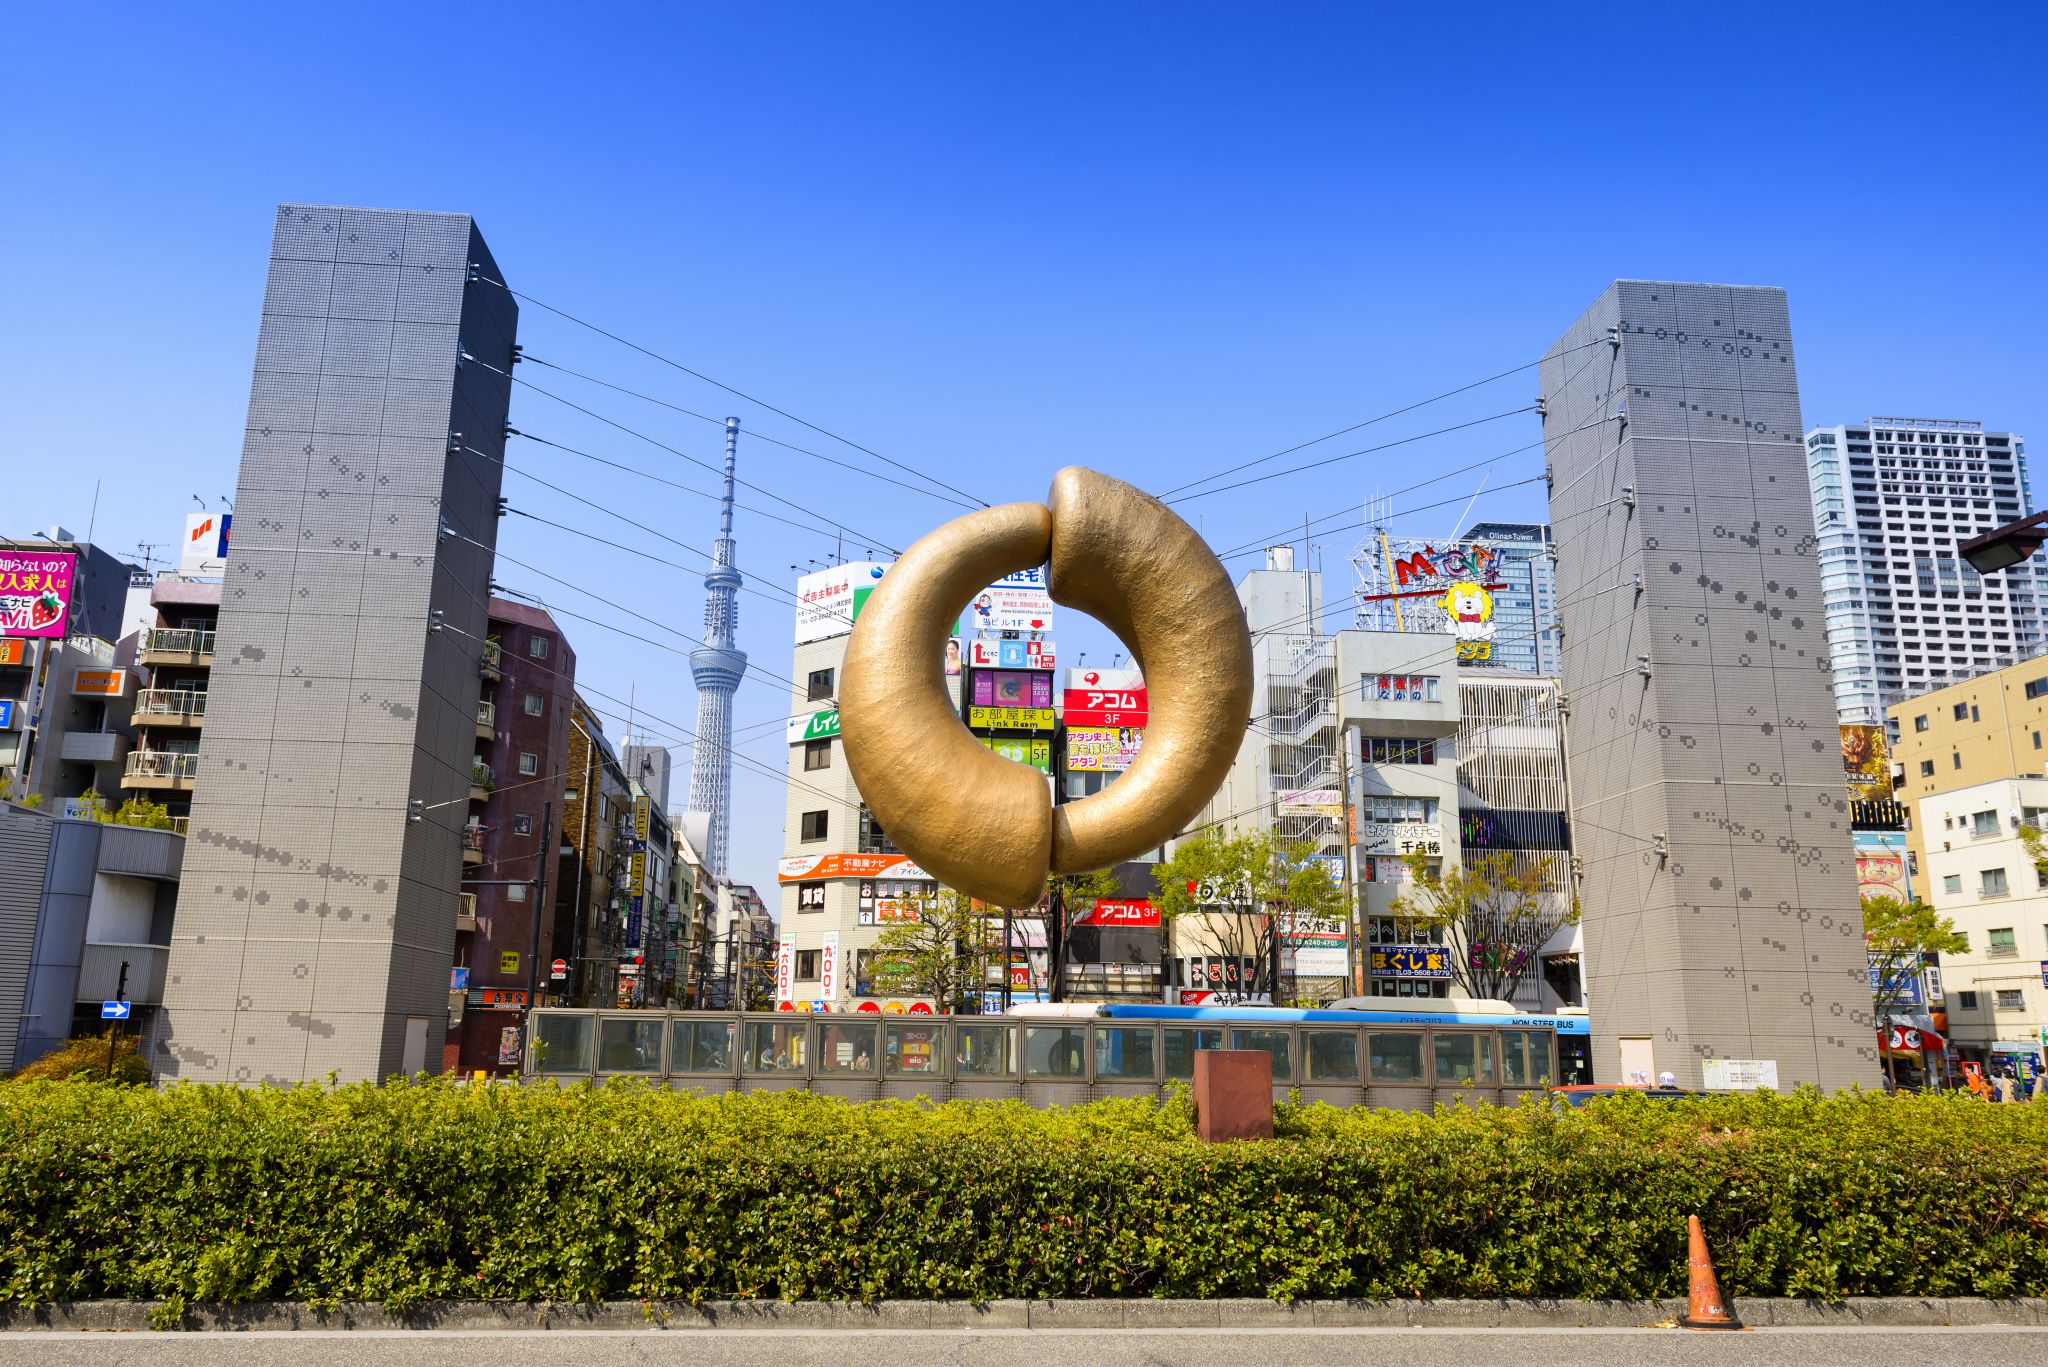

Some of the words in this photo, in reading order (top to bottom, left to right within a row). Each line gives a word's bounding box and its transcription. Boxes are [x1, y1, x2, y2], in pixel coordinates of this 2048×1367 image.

[1489, 532, 1511, 540] Olinas
[1512, 532, 1533, 540] Tower
[983, 617, 1024, 627] 当ビル1F
[1456, 641, 1491, 660] チンコ
[1088, 692, 1136, 709] アコム
[1380, 690, 1422, 700] なかの
[973, 709, 1052, 721] お部屋探し
[1104, 713, 1120, 724] 3F
[1033, 748, 1048, 760] 5F
[1069, 757, 1098, 768] アタシ
[1401, 841, 1440, 855] 千点棒
[843, 858, 887, 868] 不動産ナビ
[802, 887, 825, 905] 賃貸
[1101, 905, 1141, 918] アコム
[1144, 908, 1157, 916] 3F
[1371, 953, 1442, 970] ほぐし家
[1557, 1021, 1574, 1029] BUS
[905, 1032, 927, 1040] 宝くじ
